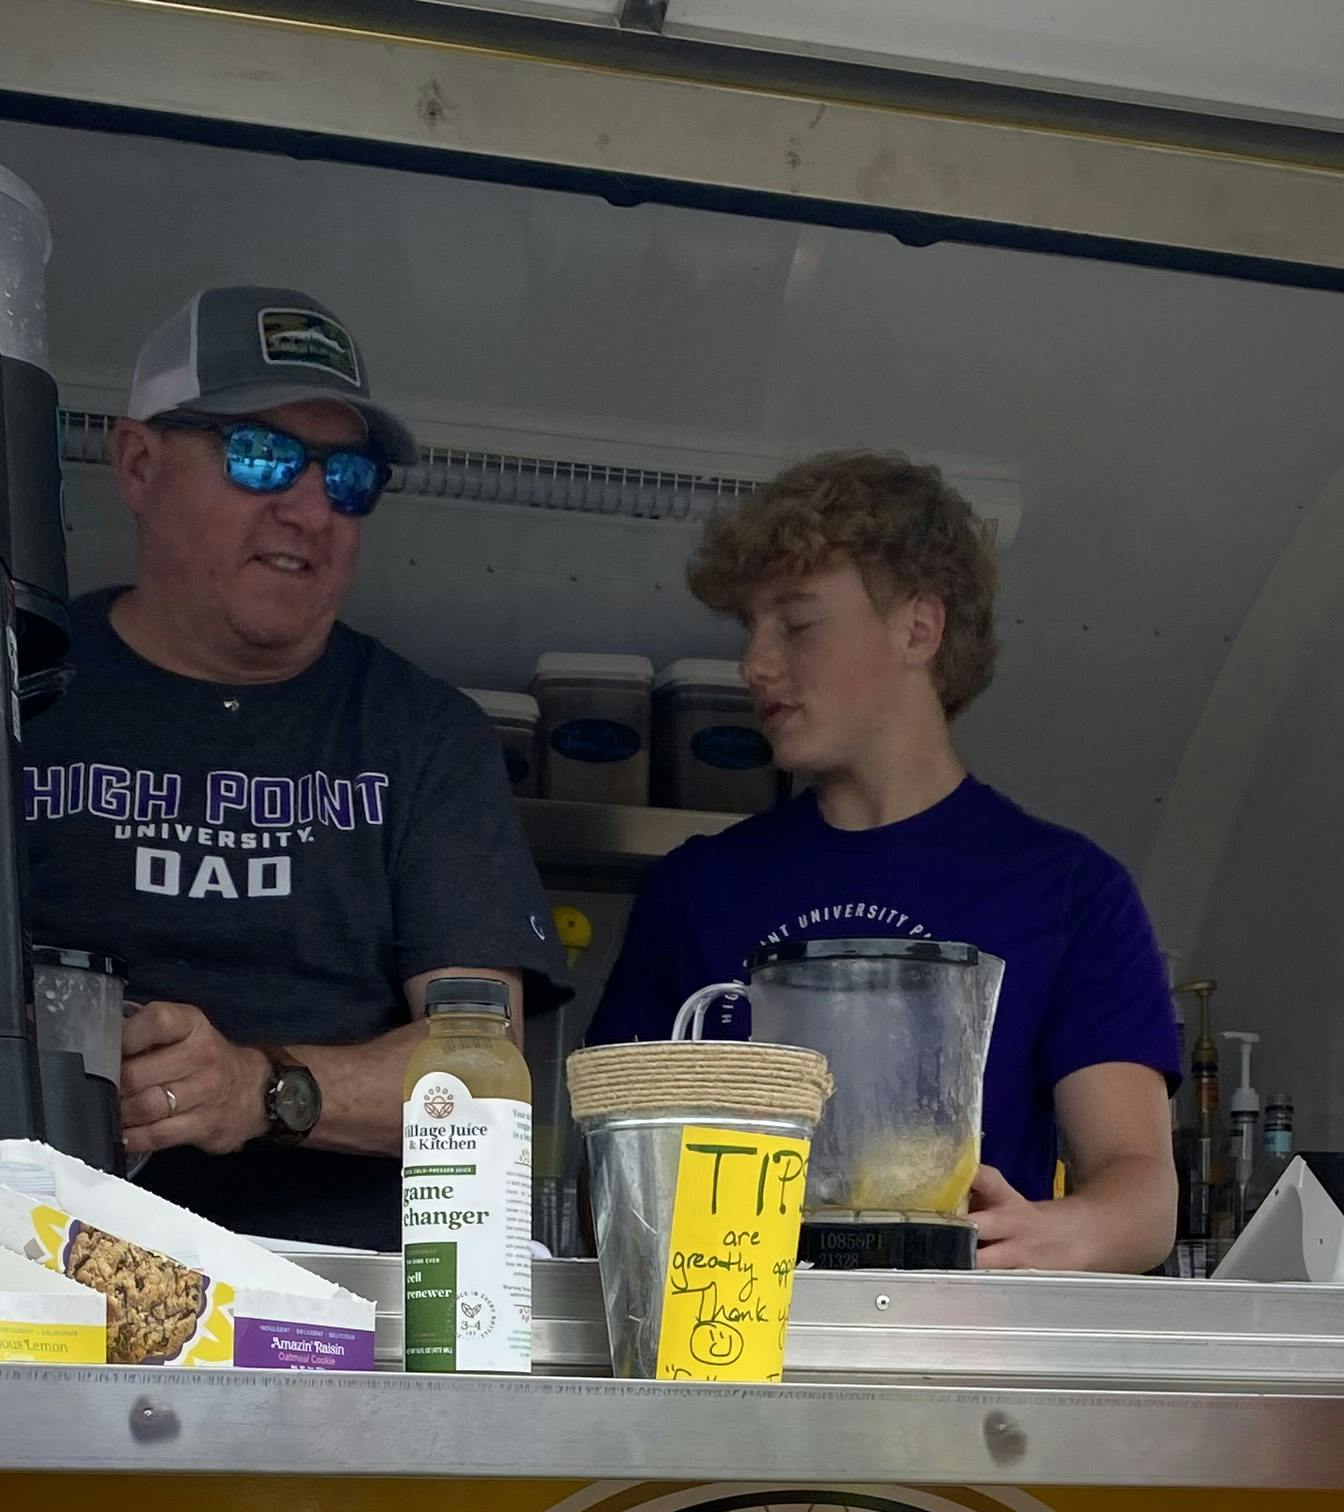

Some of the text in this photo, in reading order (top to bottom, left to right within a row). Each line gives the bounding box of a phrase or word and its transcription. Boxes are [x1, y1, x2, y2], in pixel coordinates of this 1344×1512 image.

[23, 762, 388, 830] HIGH POINT
[135, 847, 292, 899] DAD
[798, 903, 909, 928] UNIVERSITY
[405, 1122, 488, 1139] illage Juice
[419, 1138, 477, 1150] Kitchen
[403, 1185, 454, 1208] game
[403, 1208, 490, 1230] changer
[723, 1231, 760, 1247] are
[407, 1271, 422, 1283] cell
[671, 1252, 758, 1302] greatly
[407, 1289, 453, 1300] renewer
[672, 1281, 768, 1323] Thank
[23, 1339, 69, 1353] Lemon
[313, 1340, 345, 1356] Raisin
[278, 1351, 336, 1366] Oatmeal Cookie
